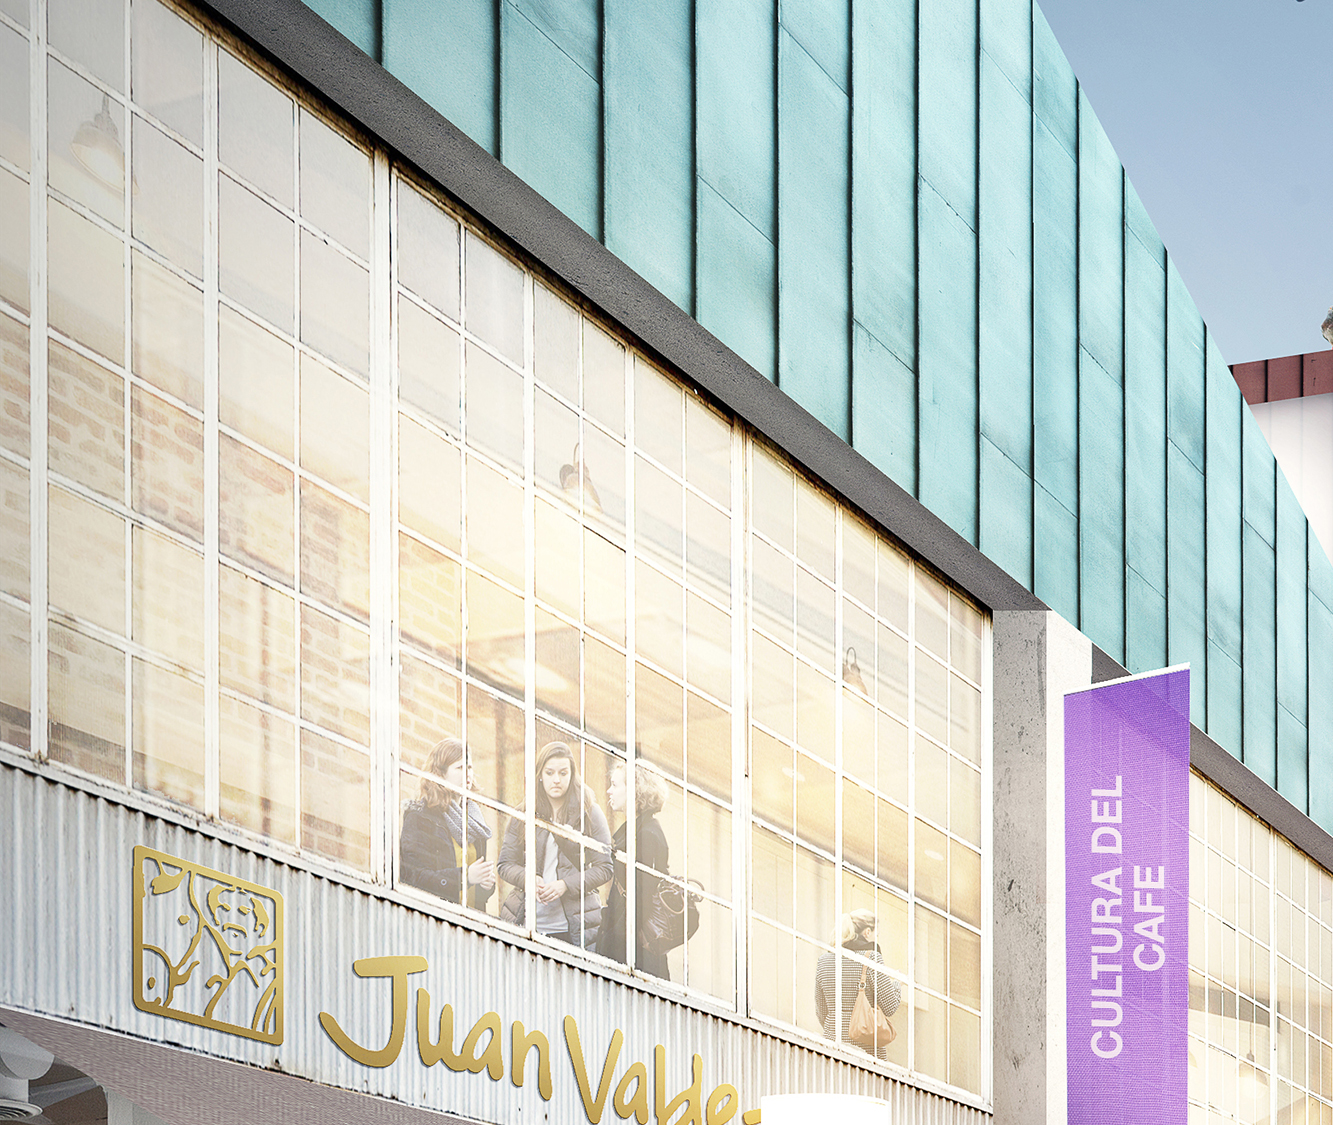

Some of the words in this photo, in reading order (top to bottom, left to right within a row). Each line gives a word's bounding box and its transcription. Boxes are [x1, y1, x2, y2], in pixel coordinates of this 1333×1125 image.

[1090, 775, 1123, 854] DEL
[1090, 866, 1124, 1059] CULTURA
[1132, 865, 1166, 972] CAFE
[319, 955, 553, 1101] Juan
